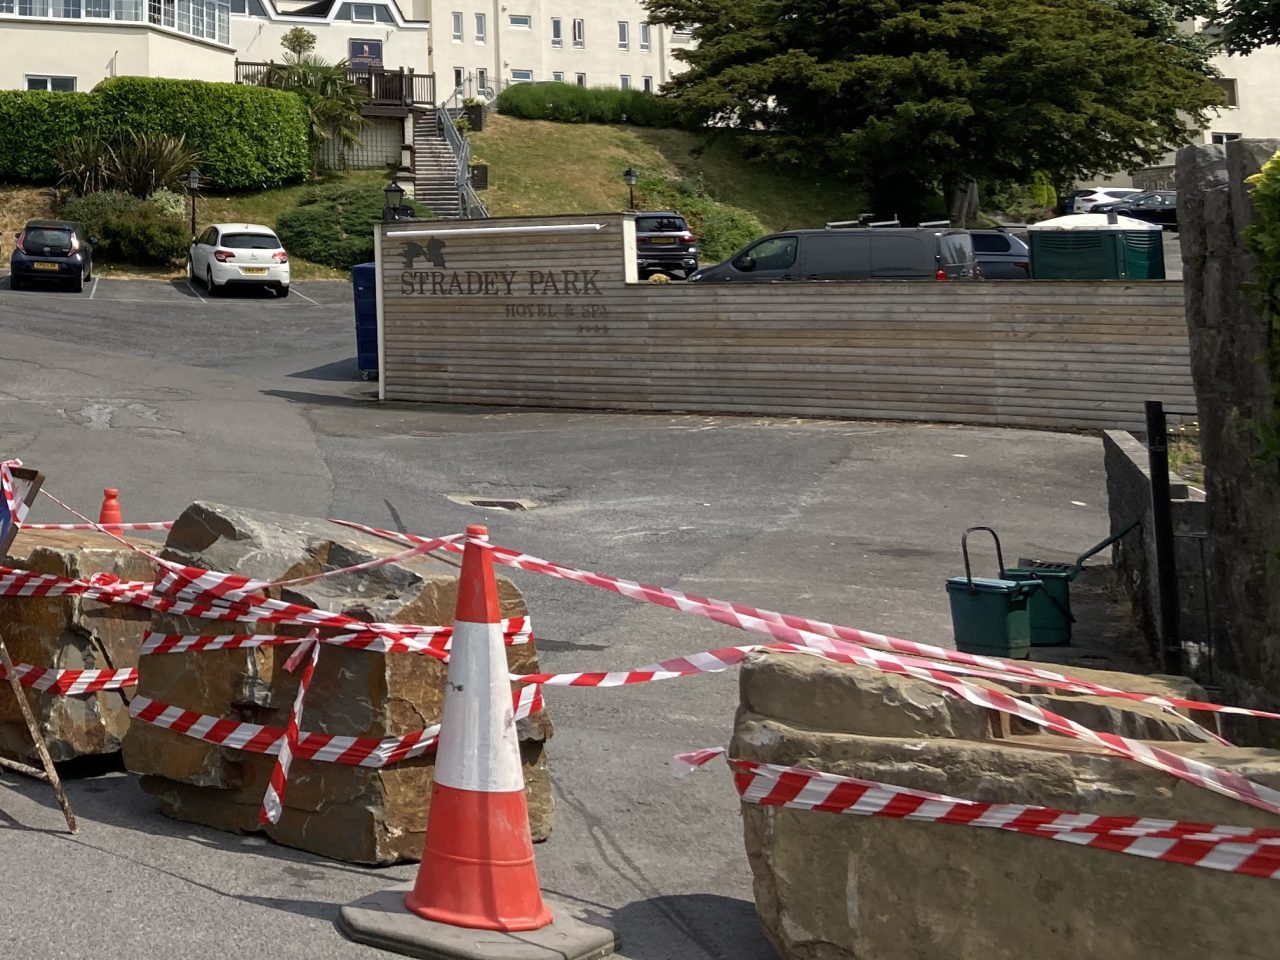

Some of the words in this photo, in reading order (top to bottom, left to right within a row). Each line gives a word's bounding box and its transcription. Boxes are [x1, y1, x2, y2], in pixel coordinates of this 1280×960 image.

[401, 271, 517, 296] STRADEY
[527, 270, 603, 295] PARK
[505, 304, 557, 318] HOTEL
[565, 303, 575, 317] &
[582, 304, 609, 318] SPA
